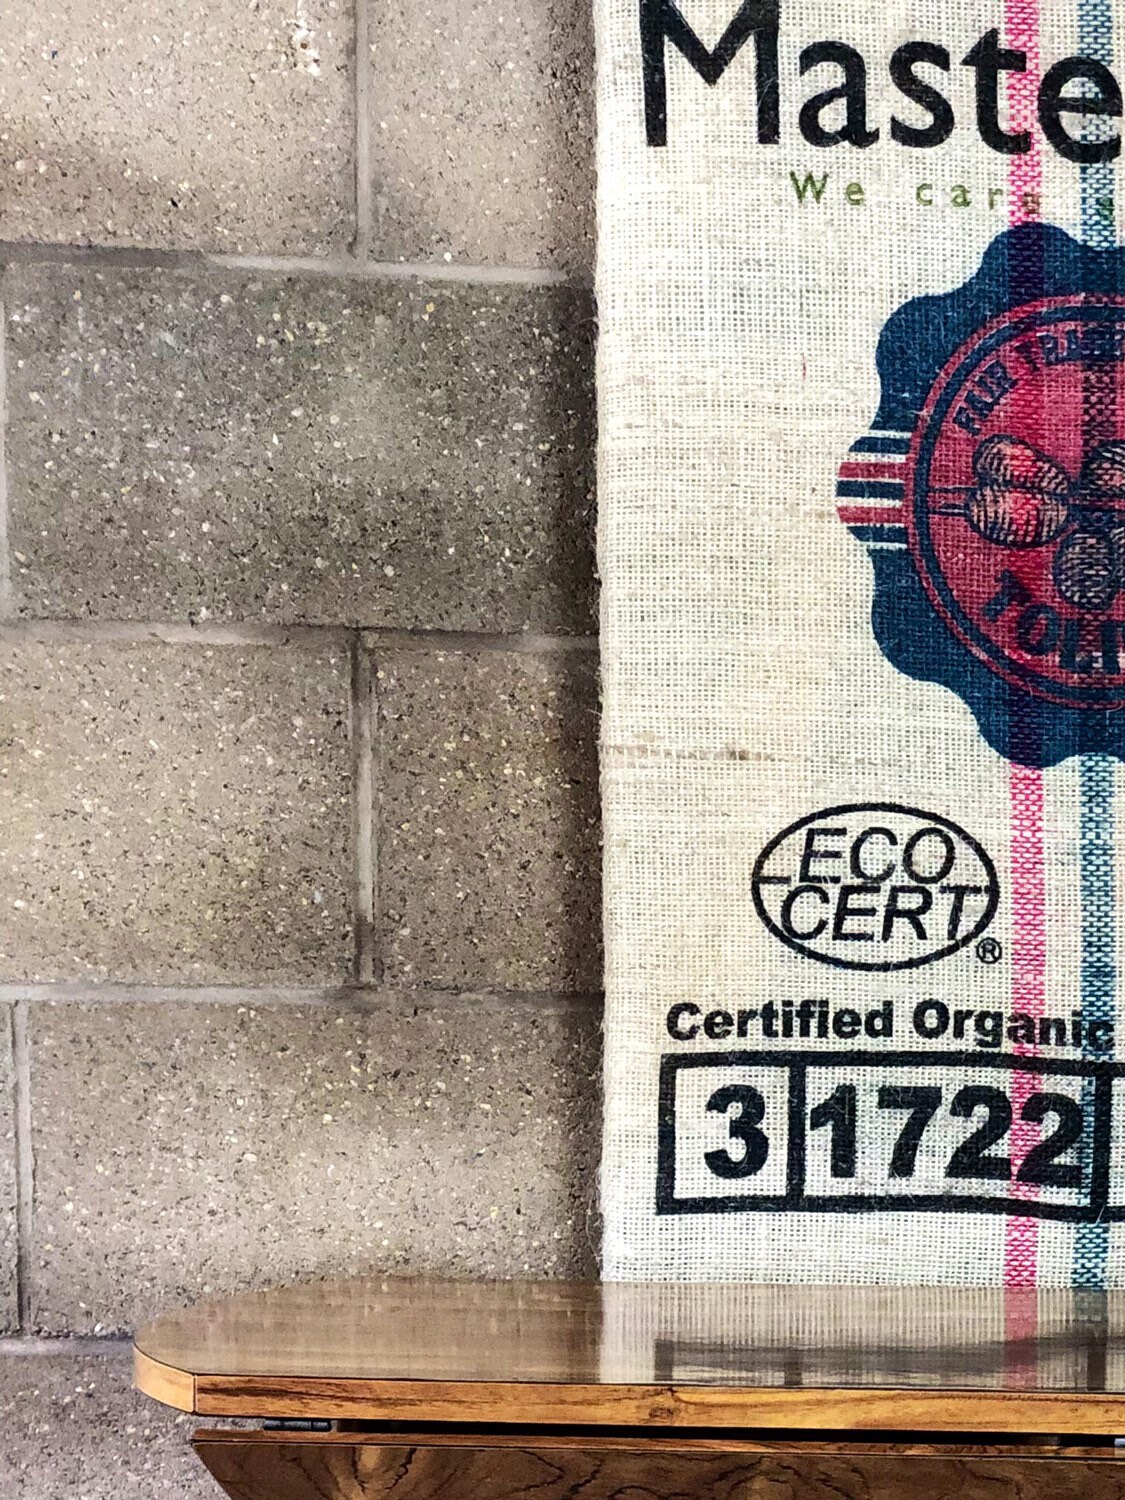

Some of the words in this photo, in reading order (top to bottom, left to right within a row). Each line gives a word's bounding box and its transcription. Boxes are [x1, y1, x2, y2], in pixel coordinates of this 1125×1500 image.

[790, 170, 865, 206] We
[915, 181, 1042, 214] care
[799, 826, 956, 884] ECO
[780, 884, 983, 942] CERT
[666, 1000, 893, 1041] Certified
[913, 1000, 1116, 1050] Organic
[704, 1085, 768, 1180] 3
[809, 1086, 1082, 1186] 17722
